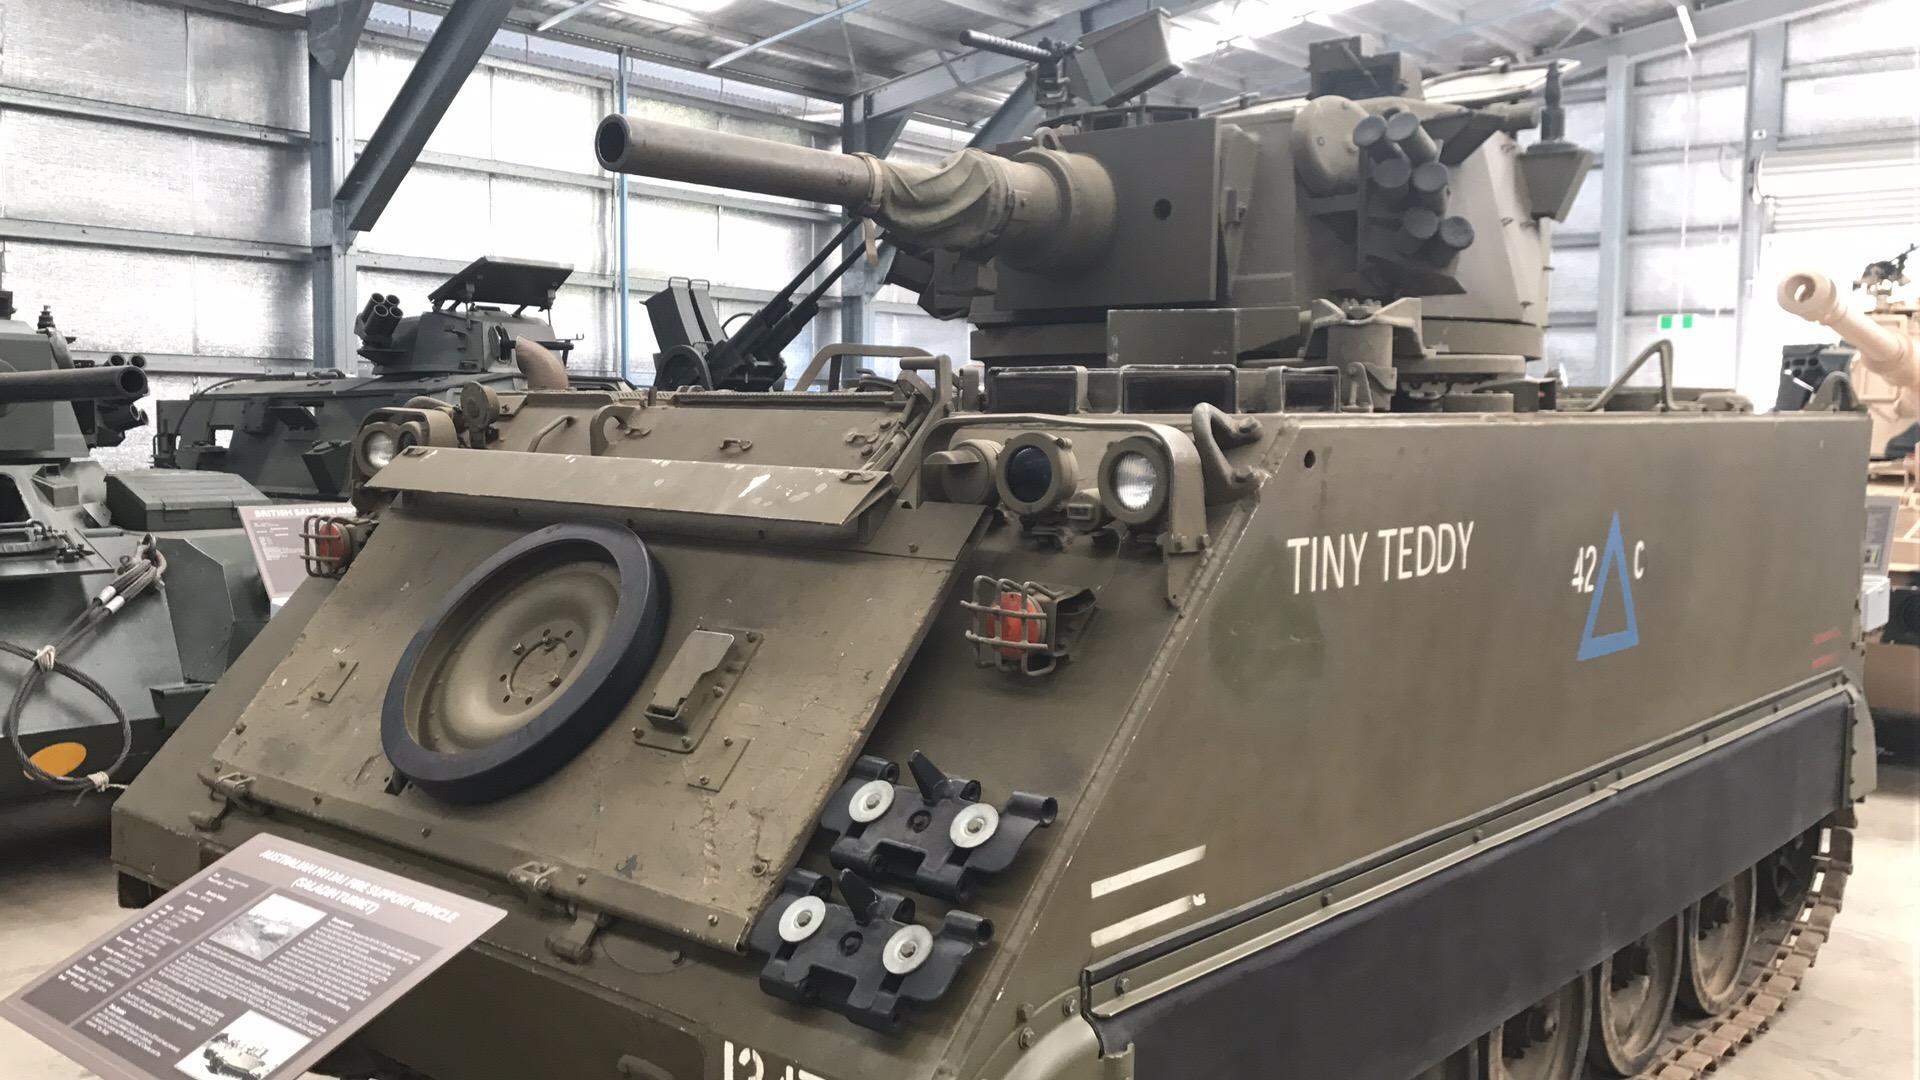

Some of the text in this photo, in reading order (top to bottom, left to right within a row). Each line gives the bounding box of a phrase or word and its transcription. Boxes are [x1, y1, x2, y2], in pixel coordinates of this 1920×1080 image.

[254, 509, 293, 518] BRITISH
[294, 507, 336, 516] SALADIN
[1287, 520, 1475, 595] TINY TEDDY
[1571, 545, 1598, 594] 42
[1633, 540, 1646, 580] C
[258, 849, 317, 875] AUSTRALIAN
[366, 885, 416, 908] SUPPORT
[411, 901, 460, 924] VEHICLE
